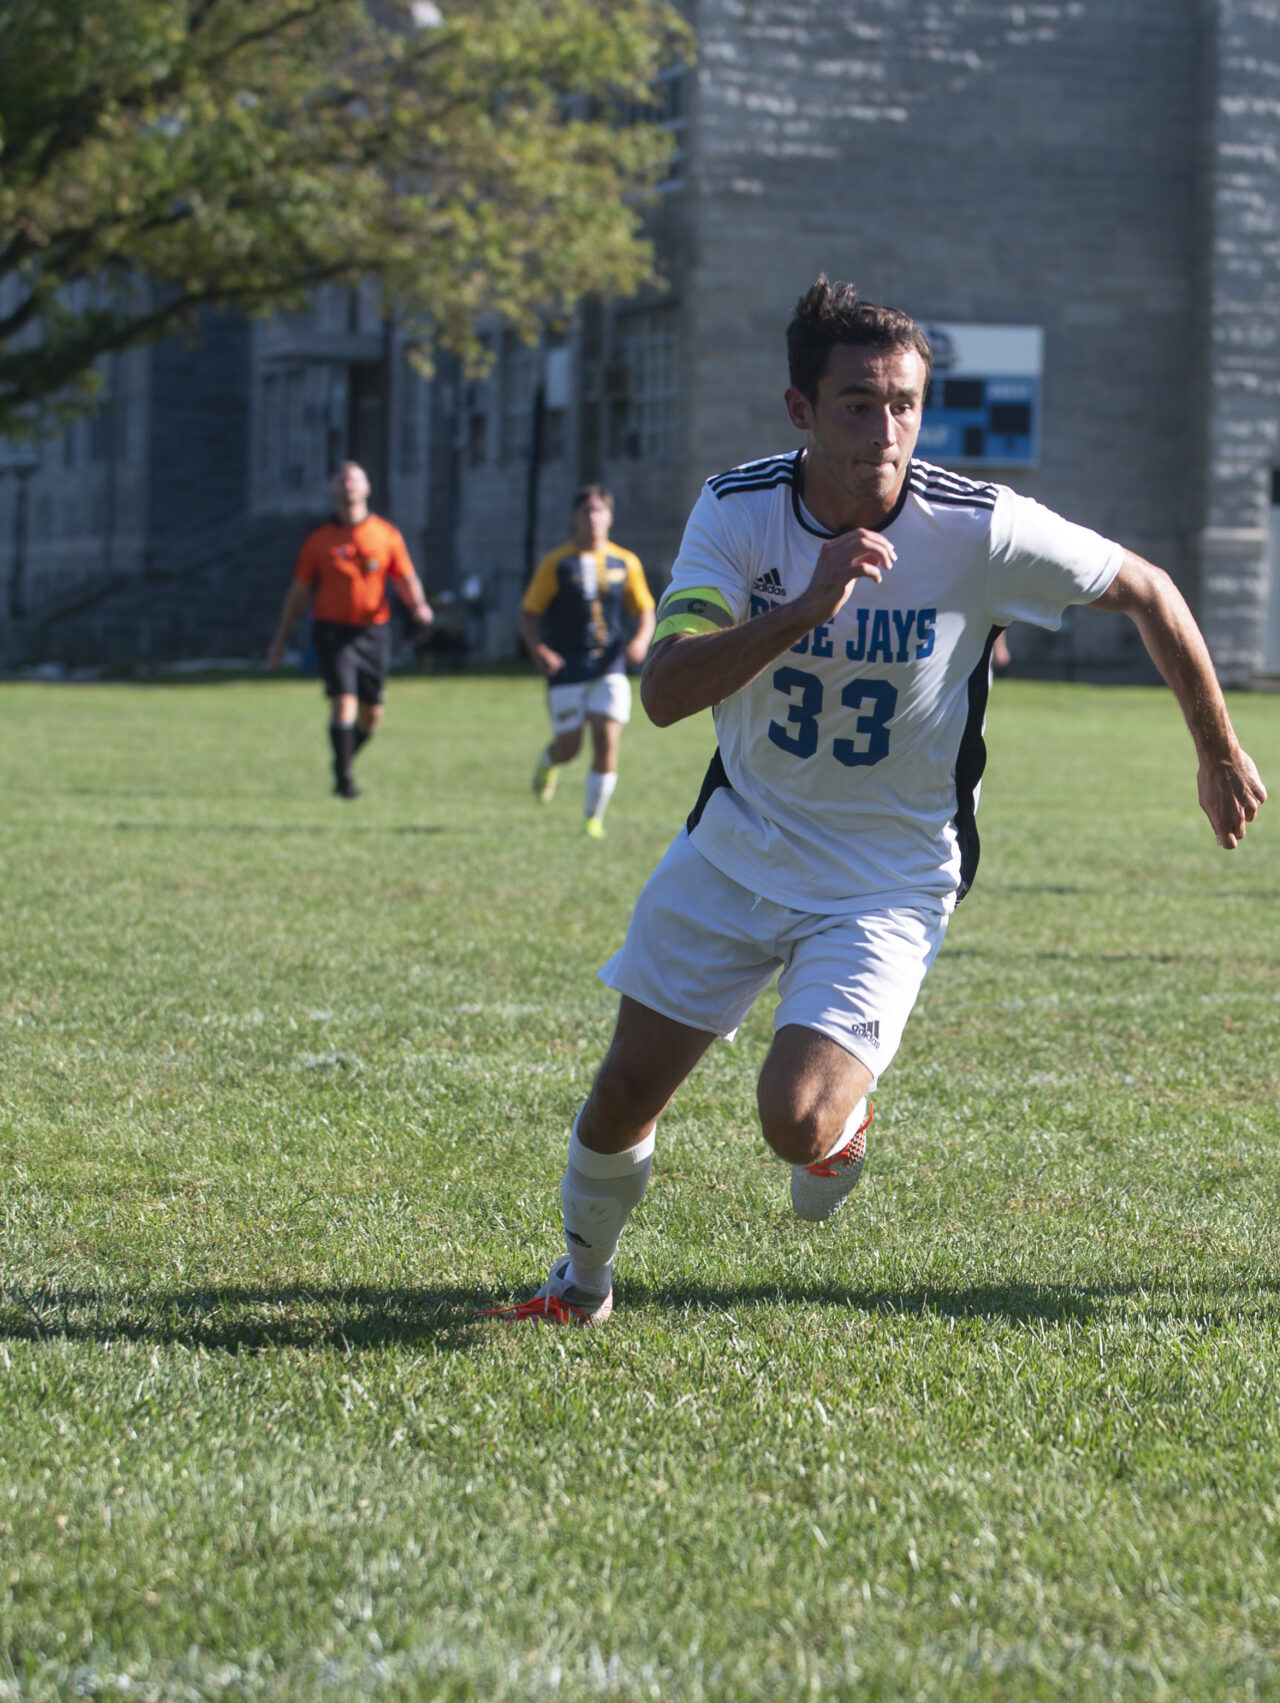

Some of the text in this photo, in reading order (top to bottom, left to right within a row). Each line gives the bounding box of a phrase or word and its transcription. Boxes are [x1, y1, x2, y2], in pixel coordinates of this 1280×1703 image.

[752, 581, 787, 597] adidas
[687, 599, 707, 615] C
[845, 607, 937, 663] JAYS
[768, 665, 898, 767] 33
[851, 1024, 880, 1049] adidas
